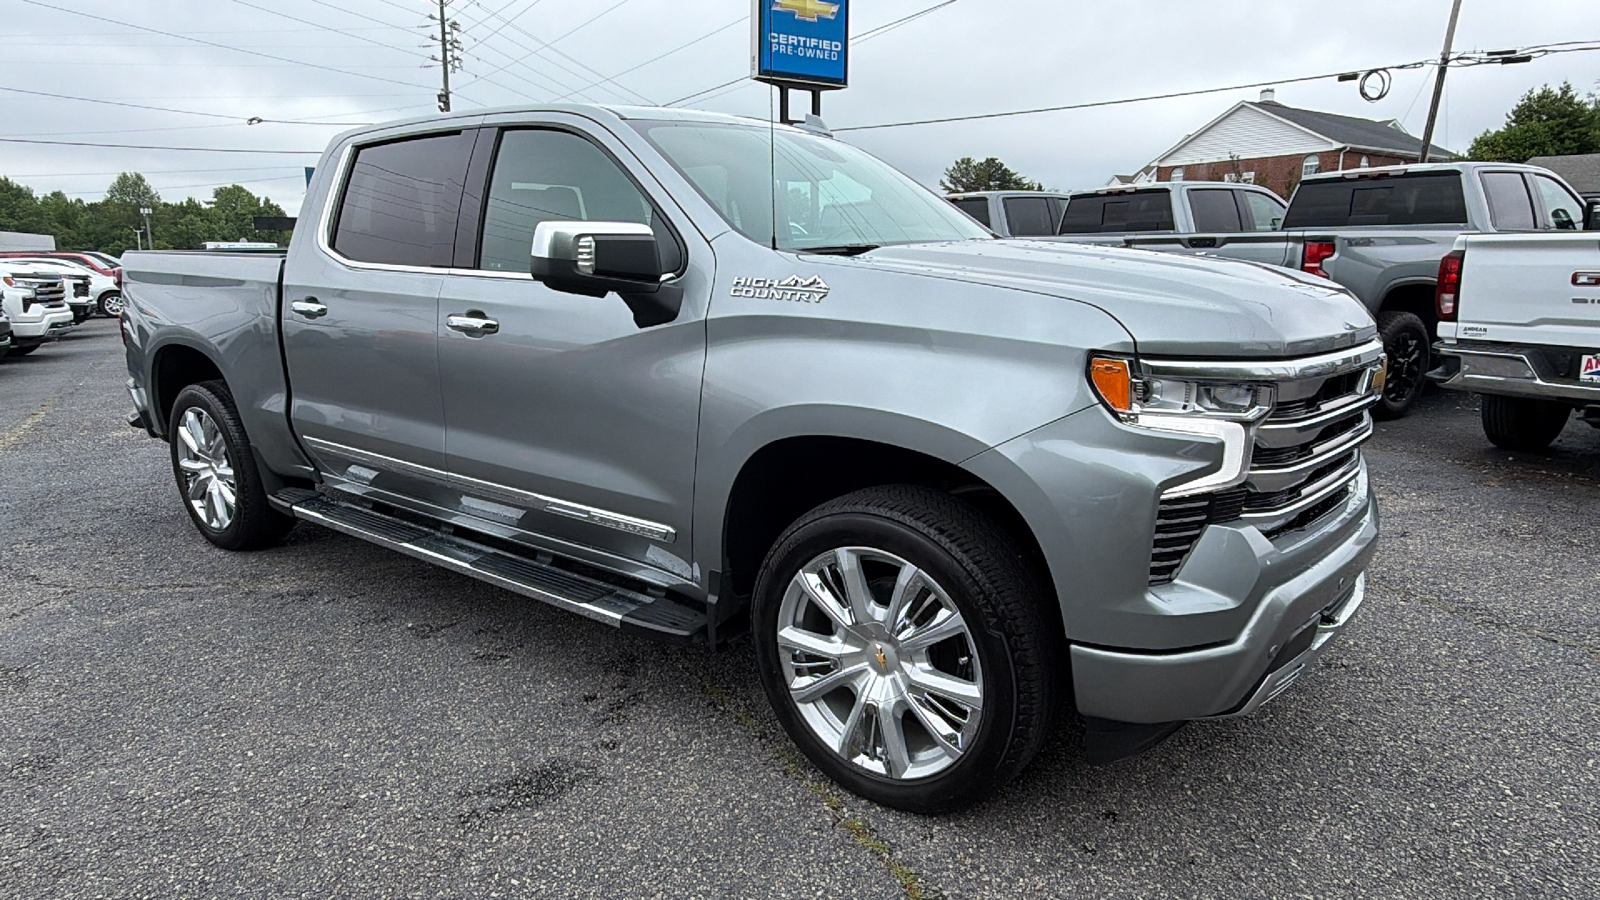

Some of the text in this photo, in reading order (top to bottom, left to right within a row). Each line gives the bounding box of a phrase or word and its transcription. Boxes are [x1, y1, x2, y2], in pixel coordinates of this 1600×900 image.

[768, 32, 842, 51] CERTIFIED
[772, 44, 838, 61] PRE-OWNED
[732, 276, 779, 288] HIGH
[730, 287, 827, 303] COUNTRY
